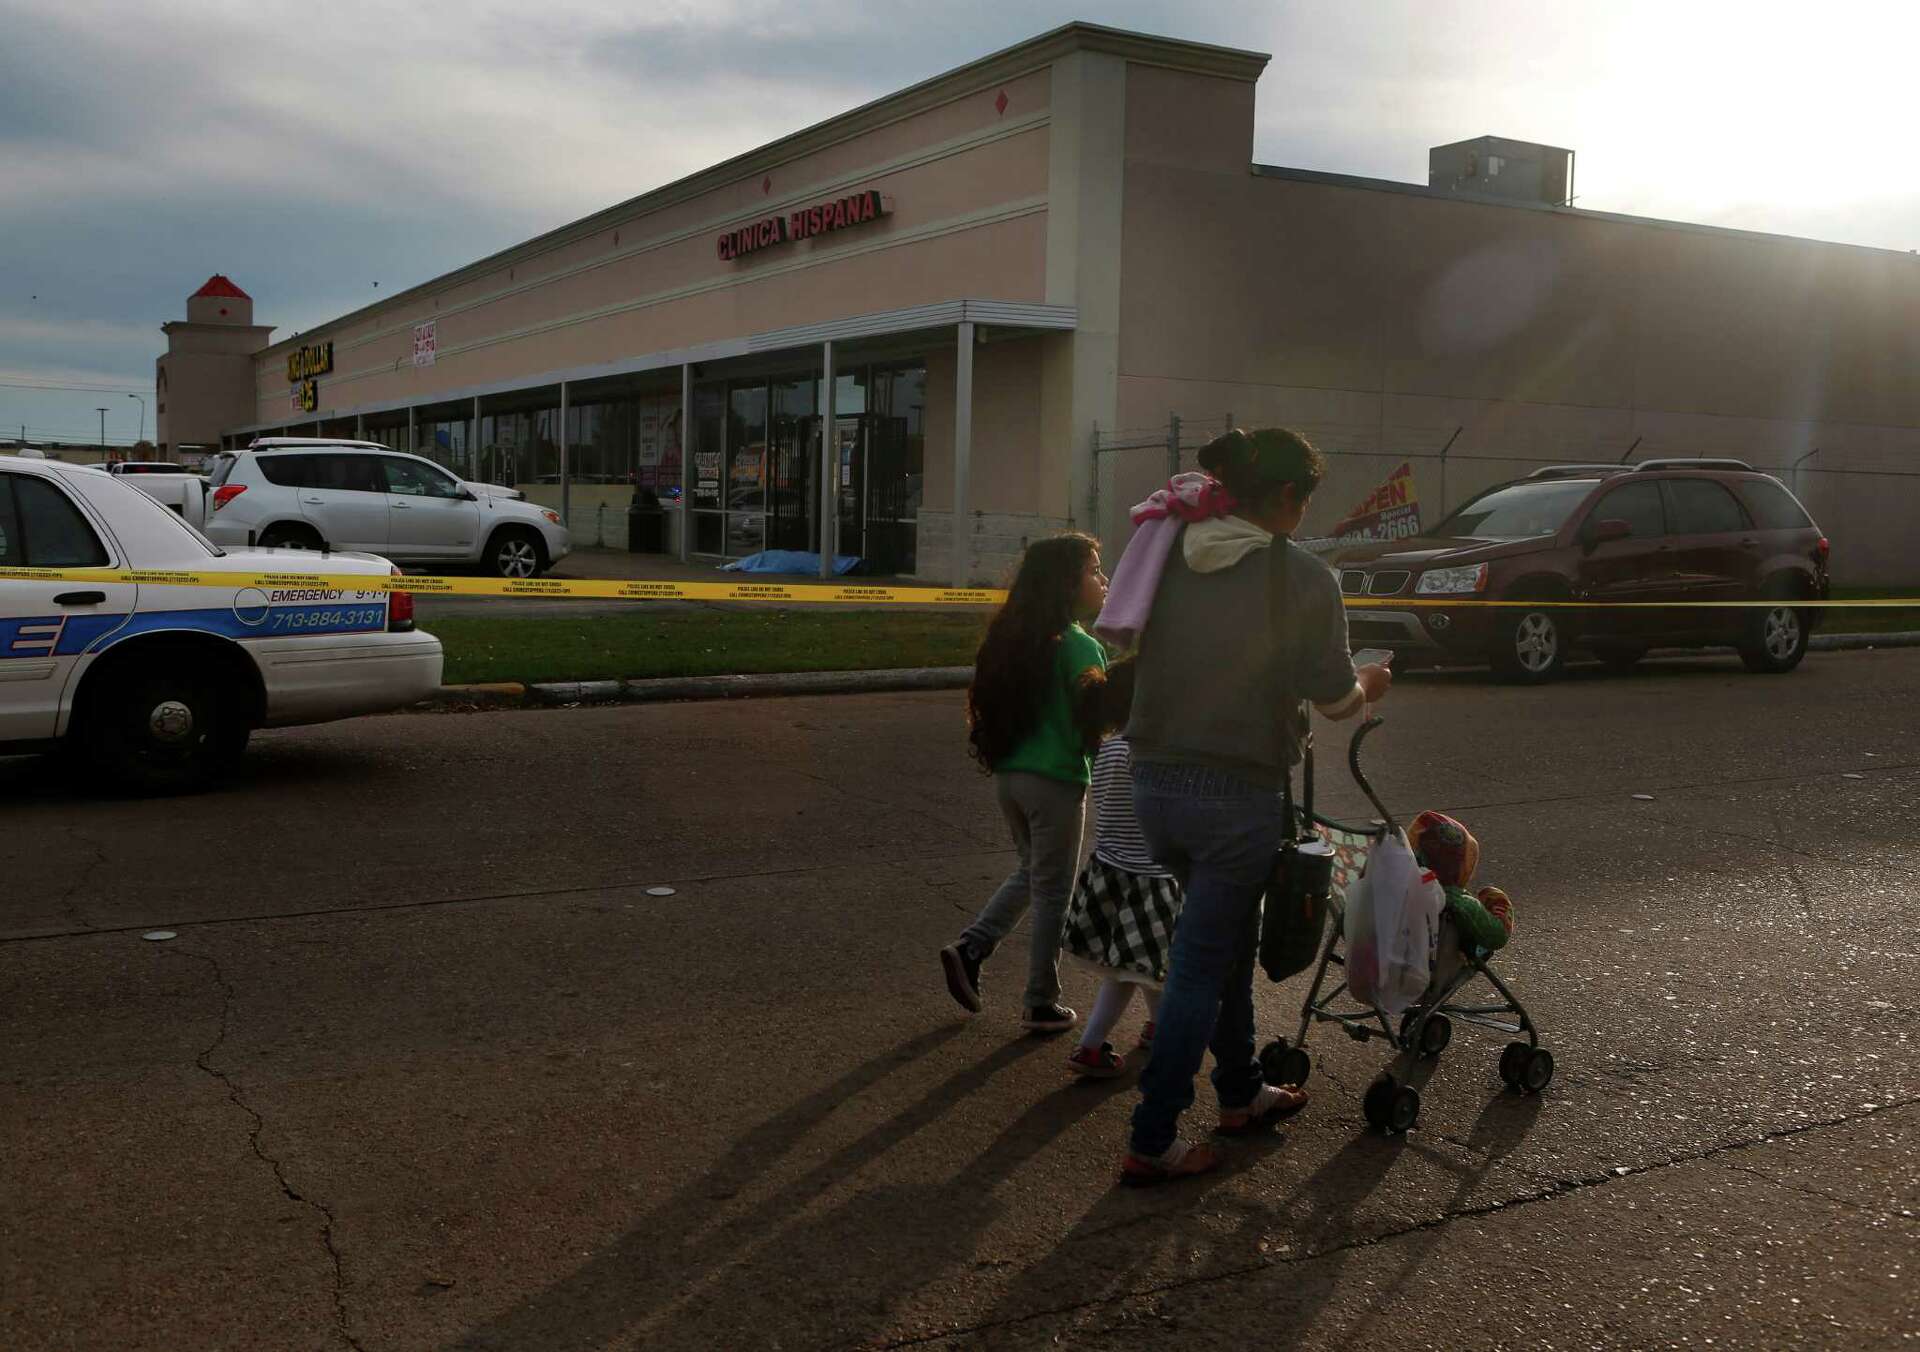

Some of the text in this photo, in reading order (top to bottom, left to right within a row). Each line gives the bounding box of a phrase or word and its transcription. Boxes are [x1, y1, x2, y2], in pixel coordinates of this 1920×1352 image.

[717, 190, 881, 260] CLINICA HISPANA
[271, 589, 345, 602] EMERGENCY
[272, 610, 384, 629] 713-884-3131
